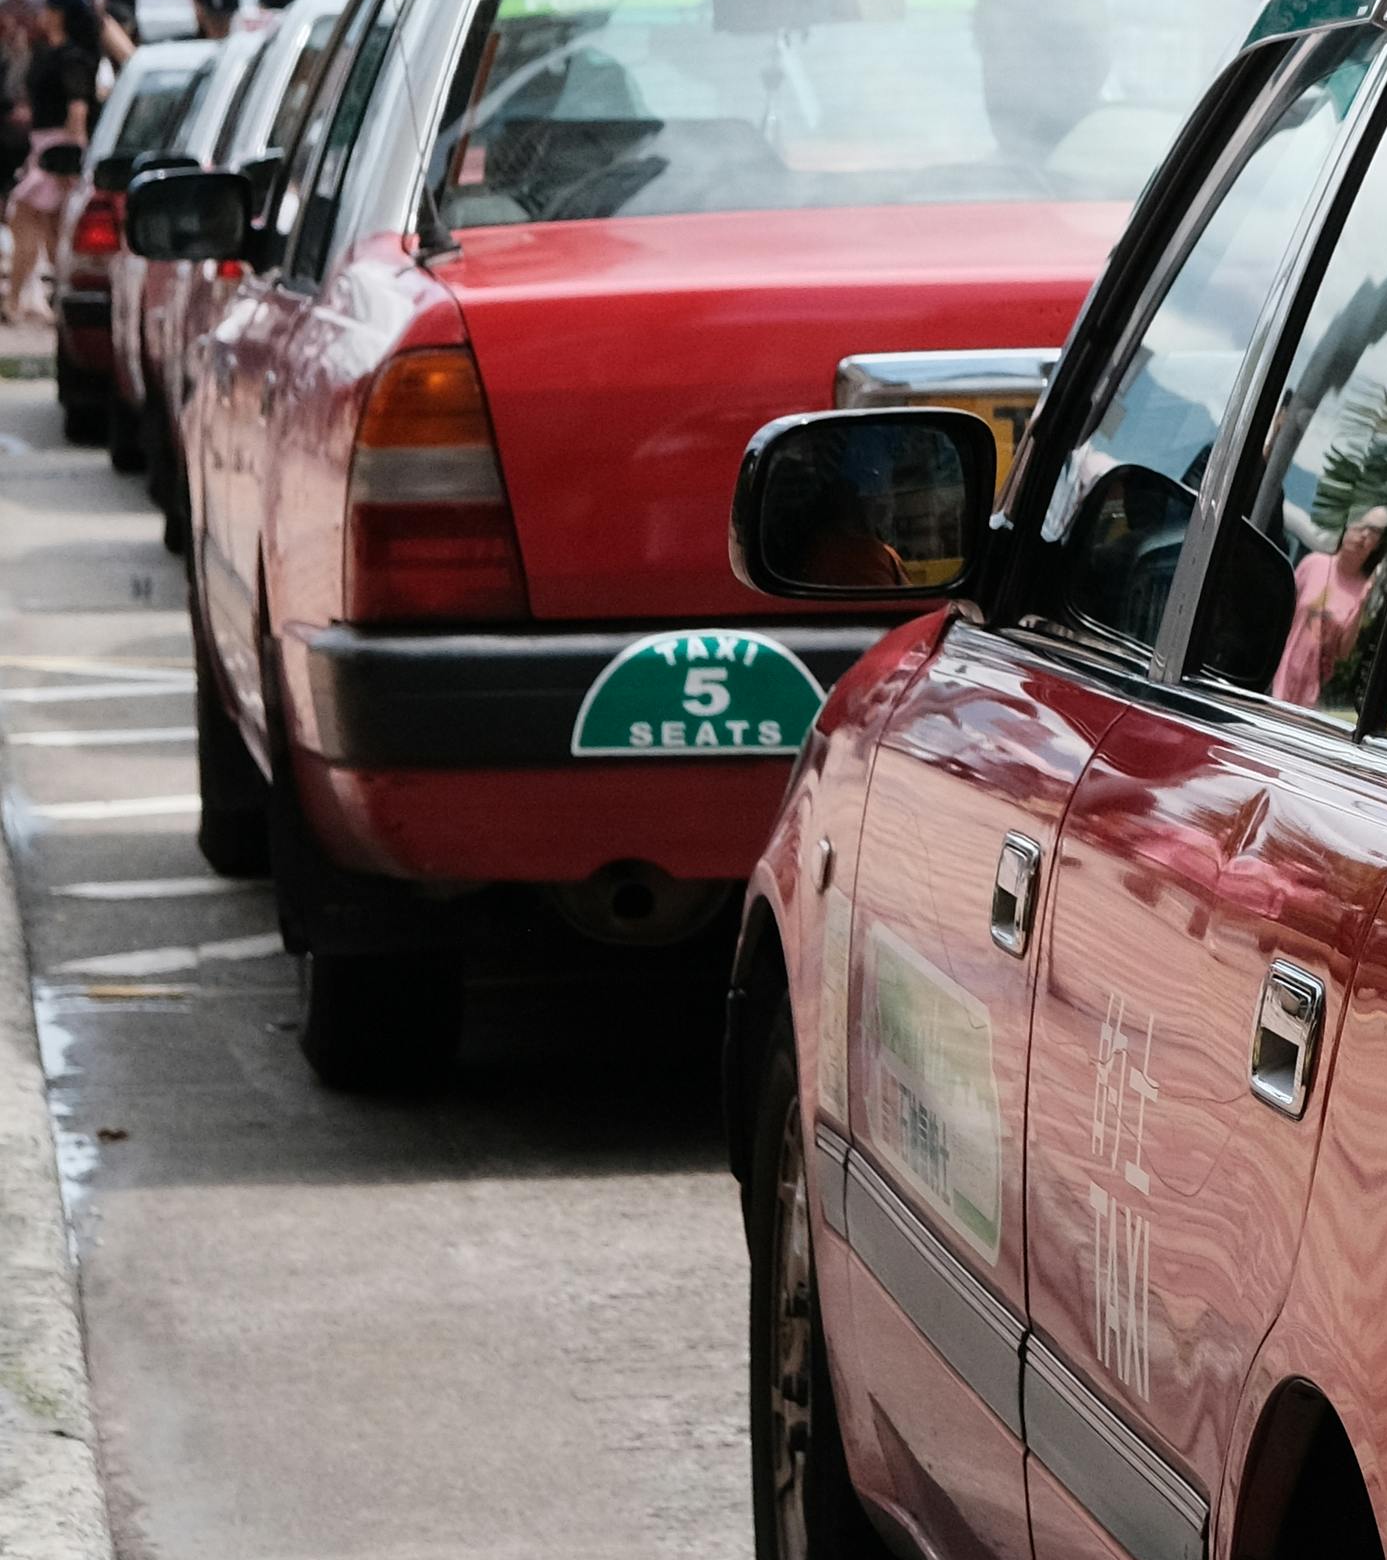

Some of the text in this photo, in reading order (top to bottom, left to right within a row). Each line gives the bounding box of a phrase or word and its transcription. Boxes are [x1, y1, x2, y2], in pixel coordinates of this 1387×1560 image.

[653, 635, 759, 667] TAXI
[682, 667, 731, 717] 5
[628, 720, 783, 748] SEATS
[1089, 1180, 1151, 1403] TAXI
